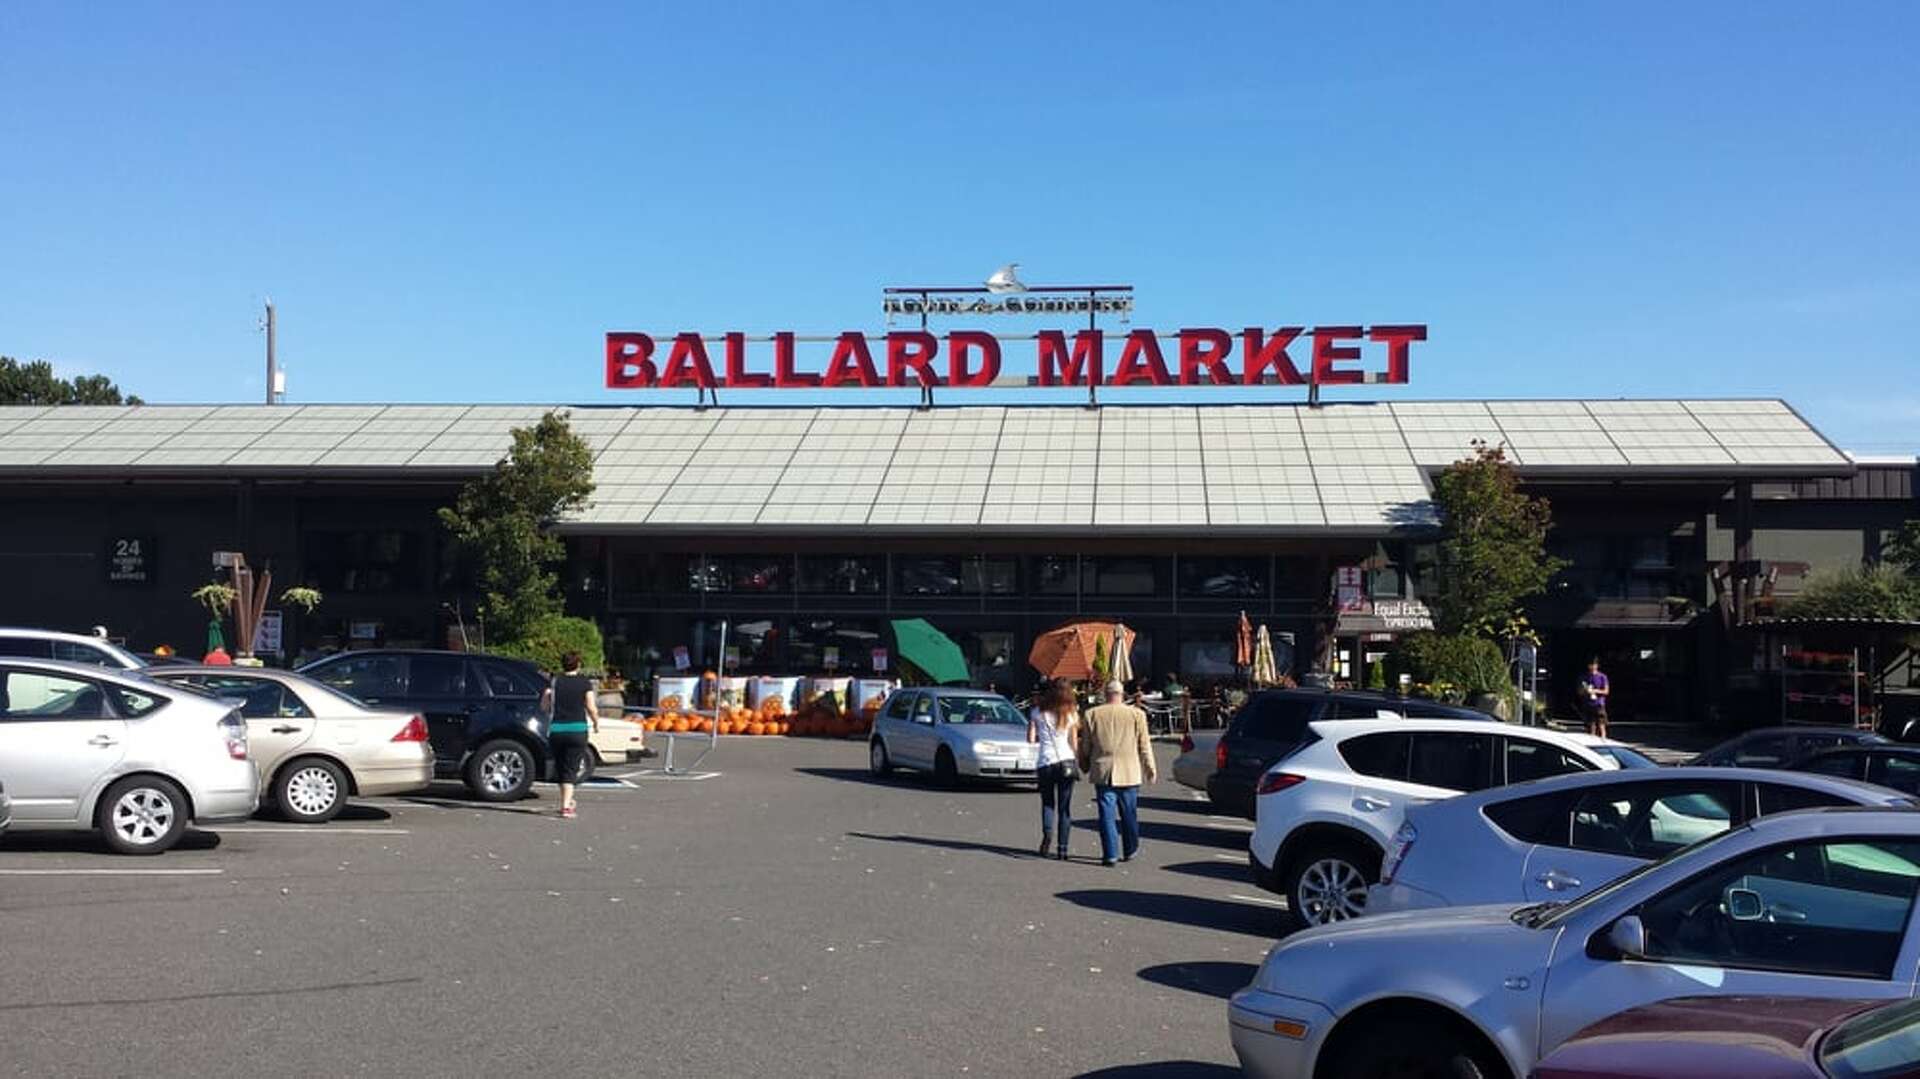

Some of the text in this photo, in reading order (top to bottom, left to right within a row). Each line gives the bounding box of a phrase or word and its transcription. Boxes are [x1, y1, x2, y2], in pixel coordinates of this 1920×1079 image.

[606, 325, 1427, 388] BALLARD MARKET
[116, 540, 140, 556] 24
[1374, 601, 1400, 616] Equal
